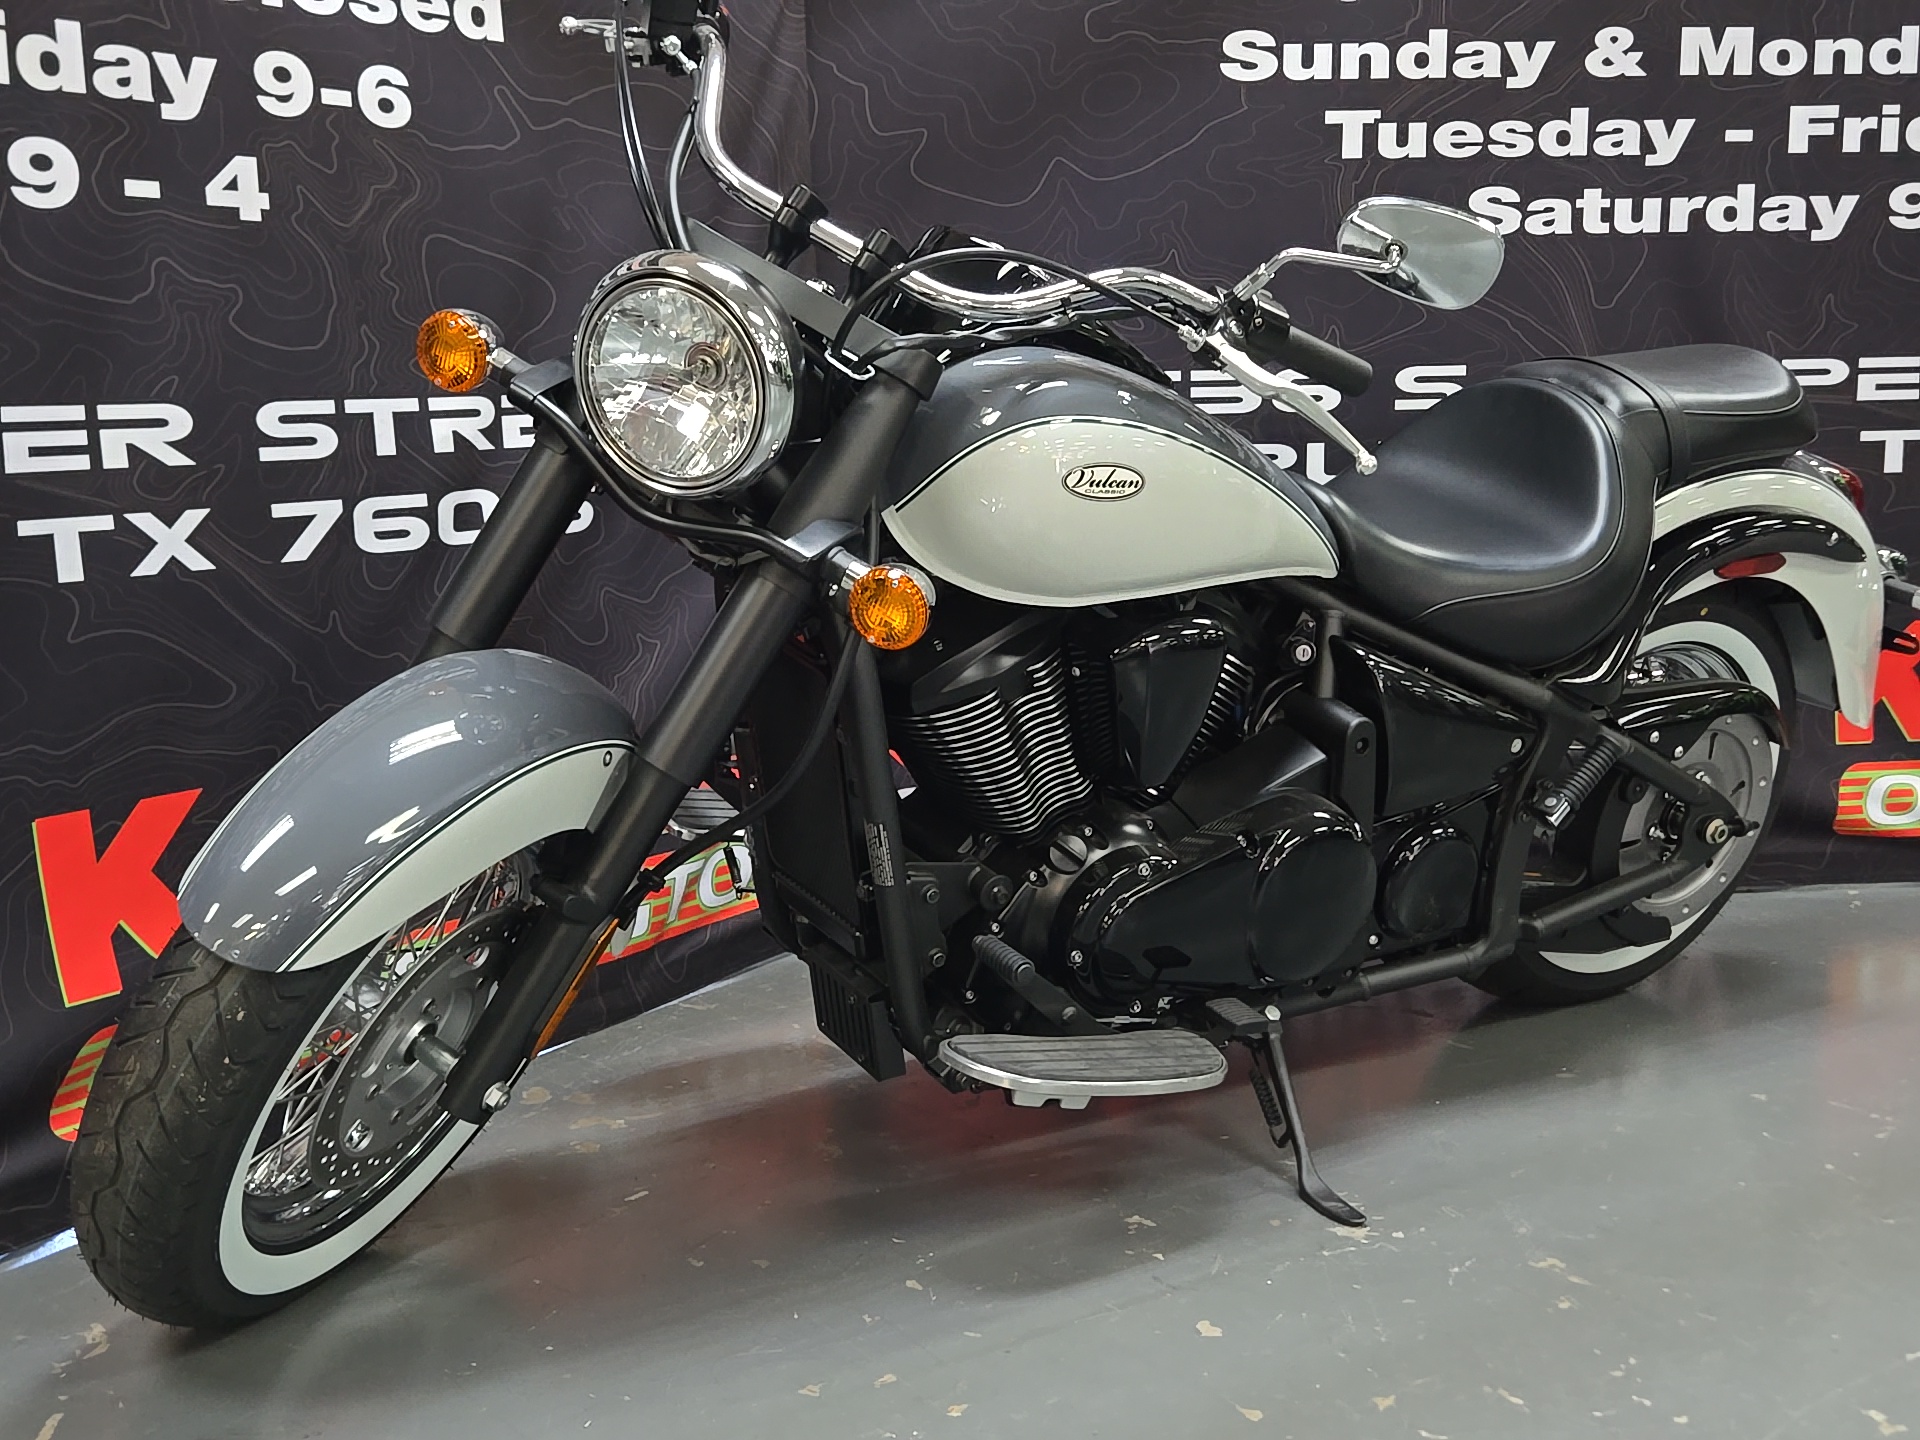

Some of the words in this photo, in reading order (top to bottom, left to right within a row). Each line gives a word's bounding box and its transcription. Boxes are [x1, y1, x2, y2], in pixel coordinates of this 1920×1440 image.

[253, 50, 412, 129] 9-6
[1219, 29, 1556, 89] Sunday
[1584, 26, 1647, 77] &
[1680, 25, 1920, 76] Mond
[1324, 106, 1696, 166] Tuesday
[6, 136, 80, 209] 9
[204, 155, 271, 222] 4
[1468, 184, 1861, 242] Saturday
[0, 403, 196, 474] ER
[1071, 468, 1140, 488] Vulcan
[16, 508, 216, 583] TX
